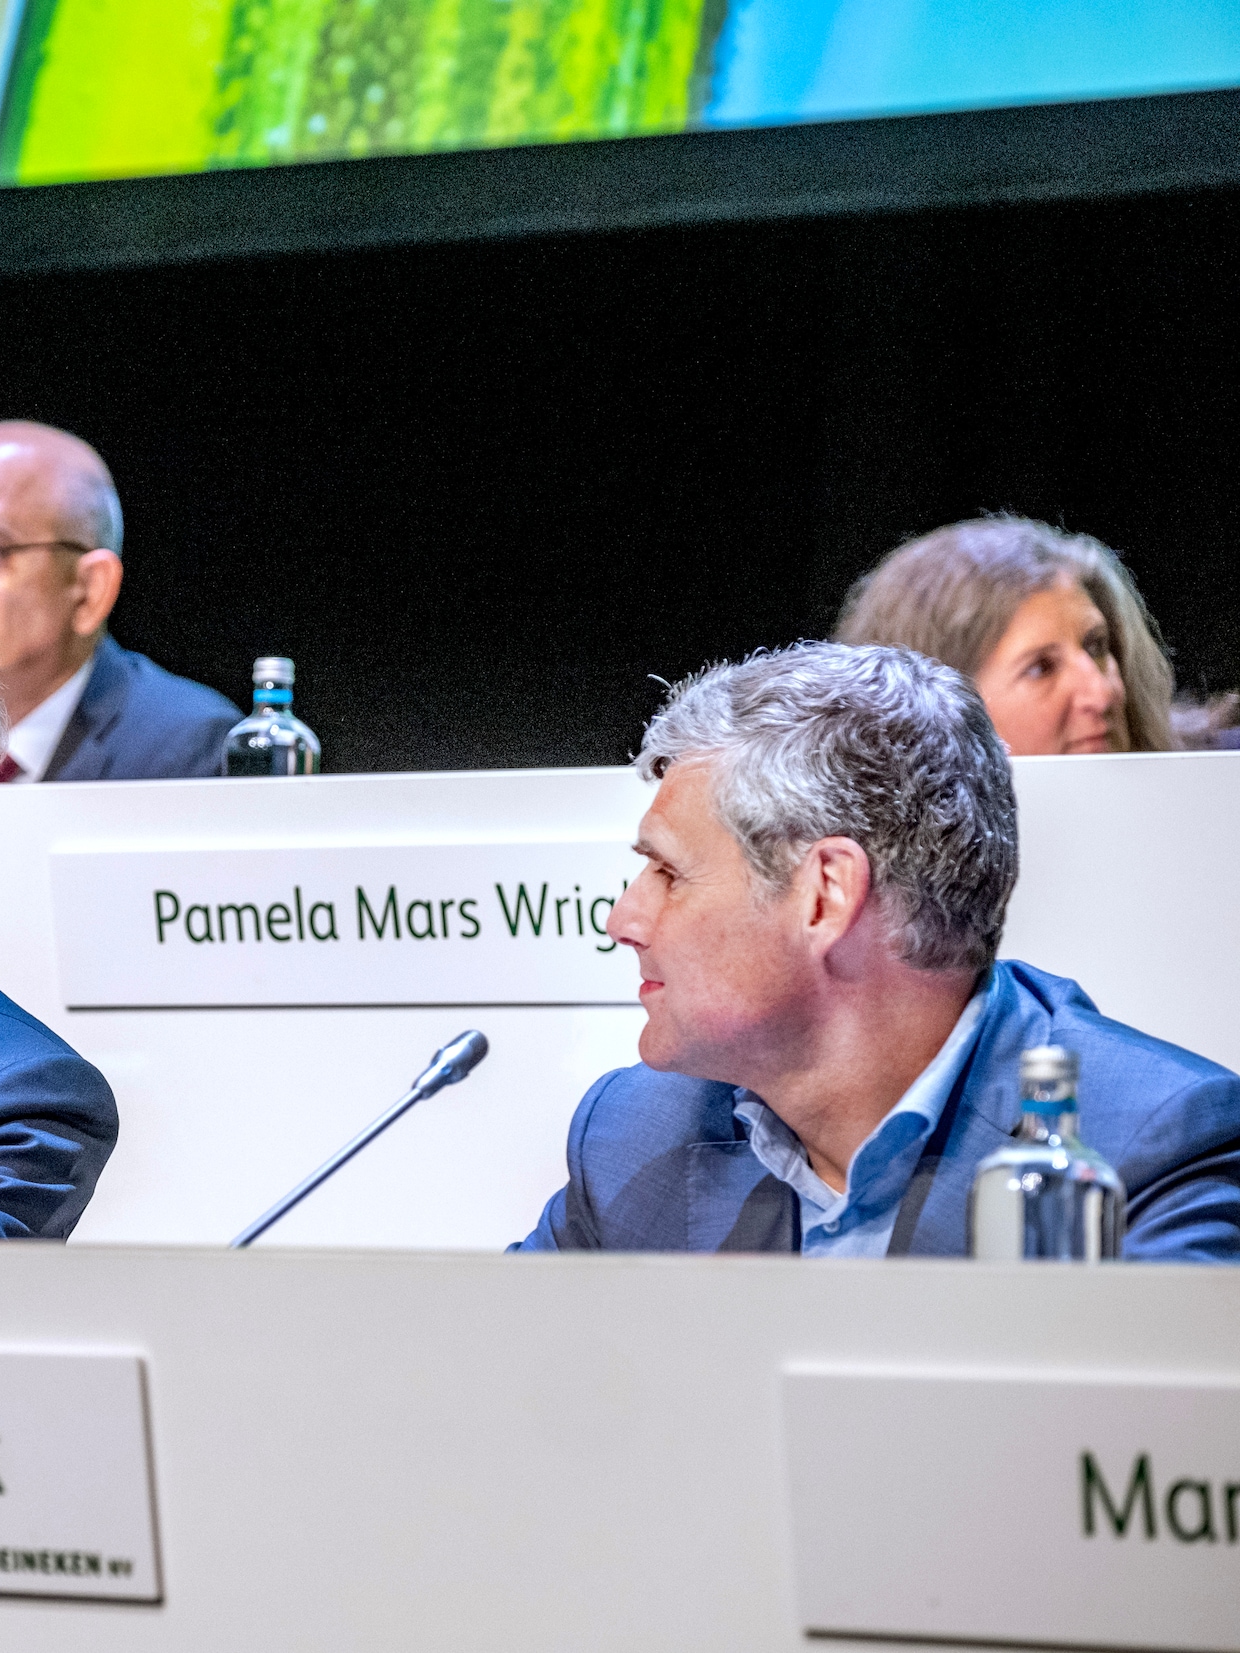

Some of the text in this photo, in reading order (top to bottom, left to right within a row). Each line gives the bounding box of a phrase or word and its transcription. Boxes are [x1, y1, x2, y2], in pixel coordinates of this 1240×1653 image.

[153, 880, 628, 953] Pamela Mars Wrig
